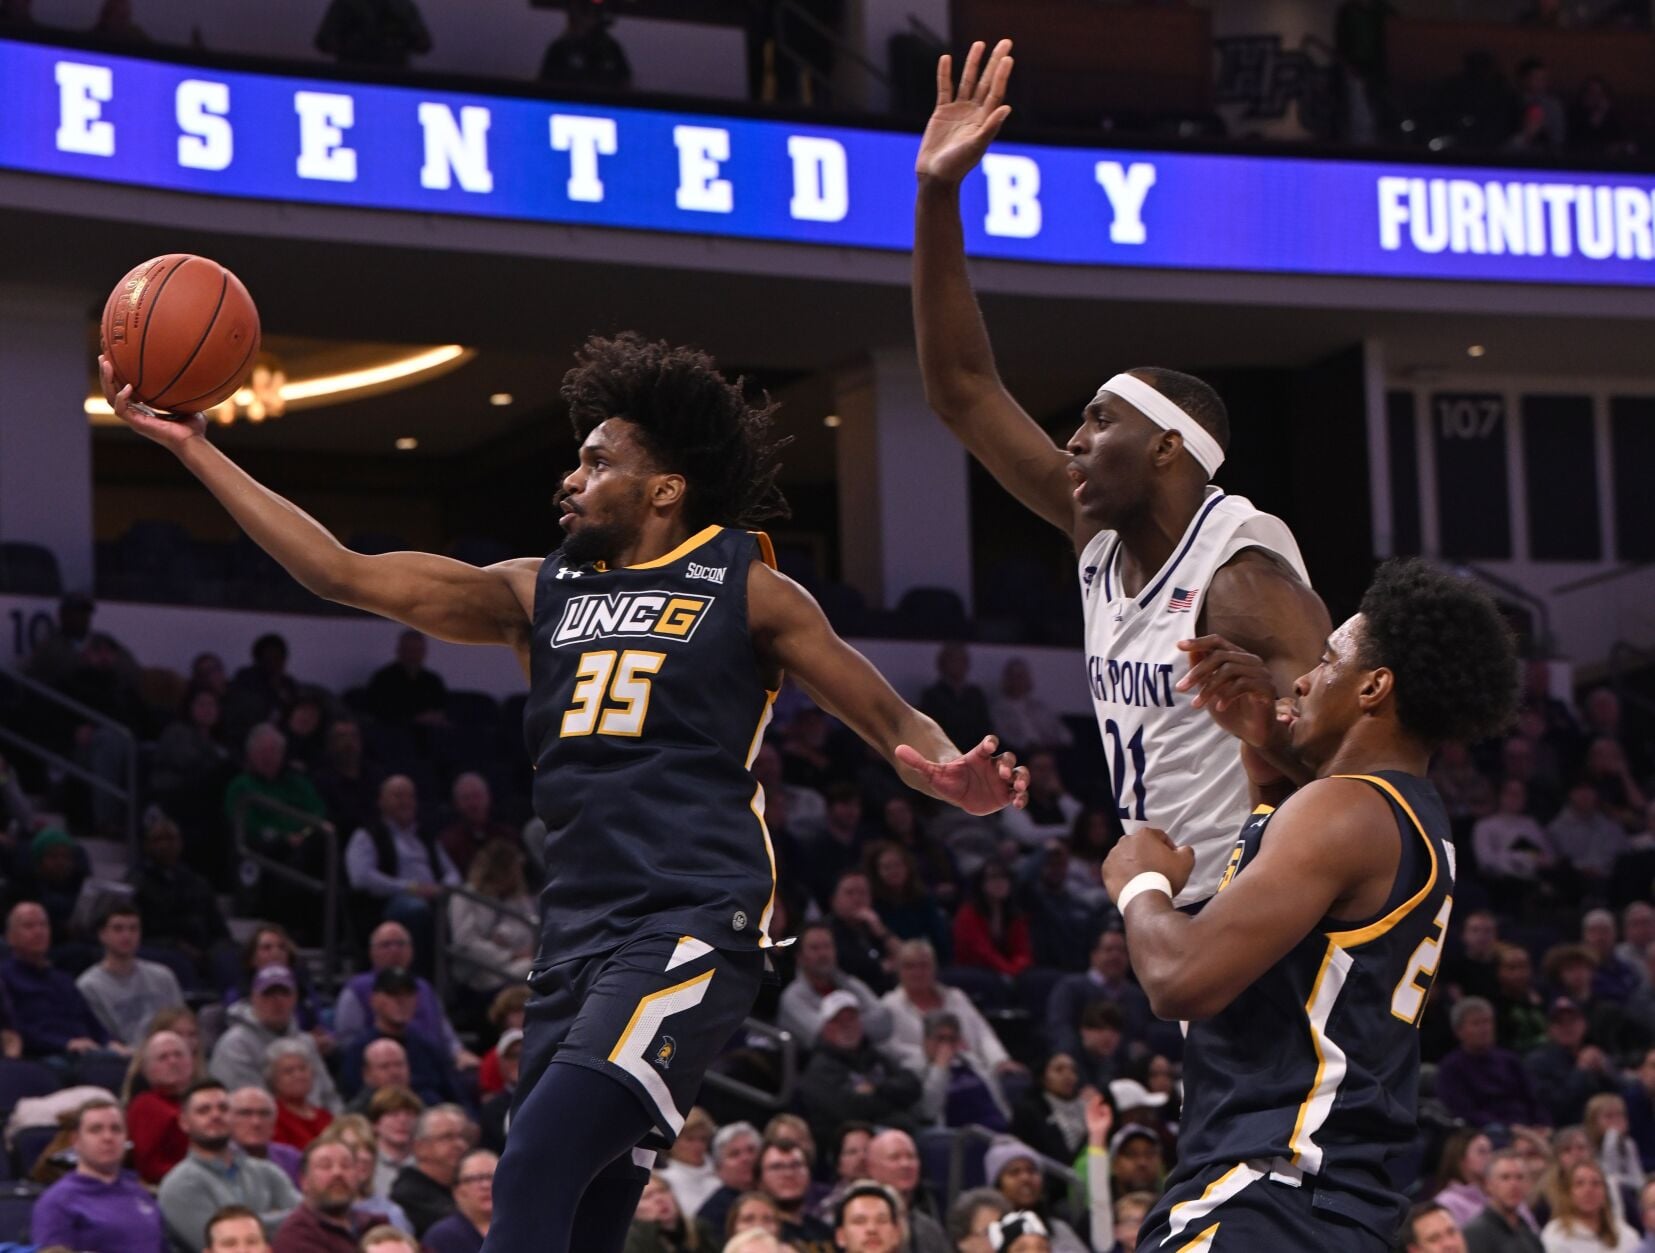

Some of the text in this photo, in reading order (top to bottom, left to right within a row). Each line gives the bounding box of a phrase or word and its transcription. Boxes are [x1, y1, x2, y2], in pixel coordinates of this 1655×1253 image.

[54, 61, 1156, 245] ESENTED BY
[1377, 176, 1655, 260] FURNITUR
[1439, 400, 1501, 439] 107
[685, 562, 727, 584] SOCON
[553, 592, 711, 646] UNCG
[559, 649, 667, 738] 35
[1107, 660, 1176, 707] POINT
[1105, 718, 1148, 821] 21
[1391, 894, 1453, 1025] 2
